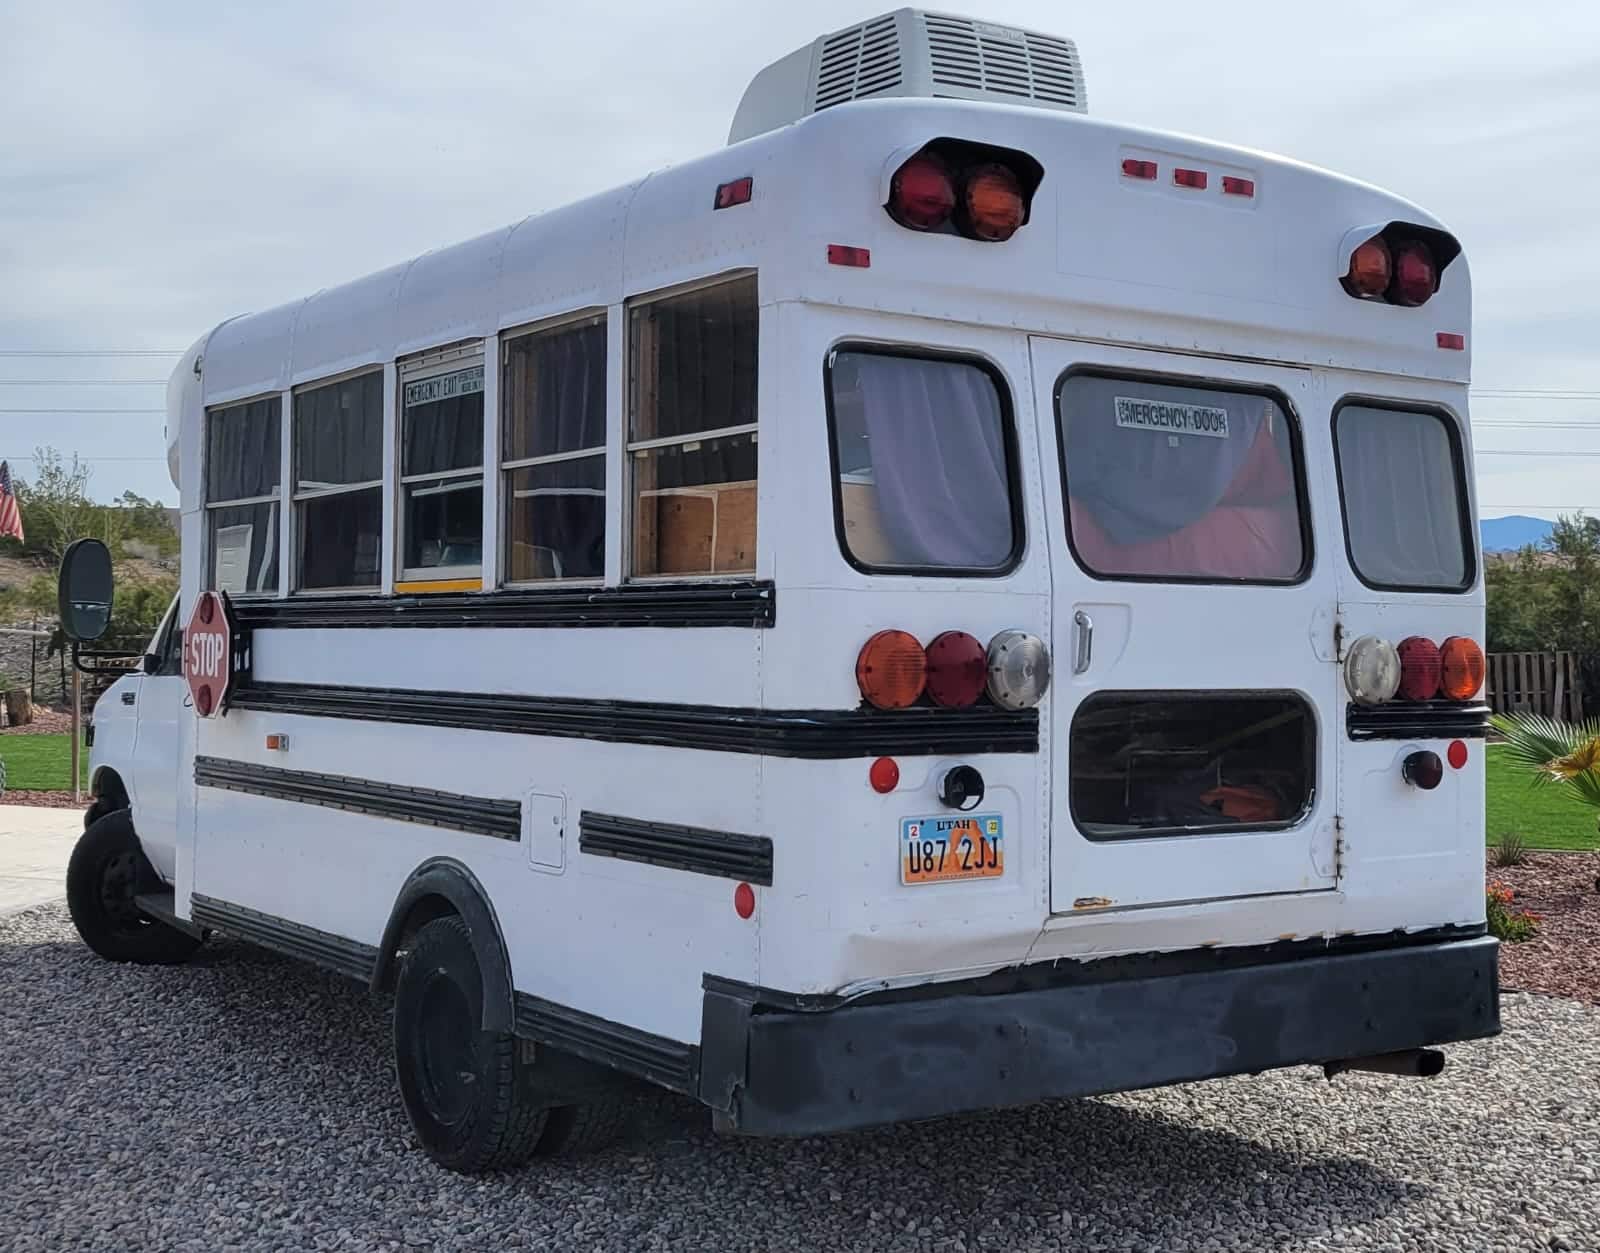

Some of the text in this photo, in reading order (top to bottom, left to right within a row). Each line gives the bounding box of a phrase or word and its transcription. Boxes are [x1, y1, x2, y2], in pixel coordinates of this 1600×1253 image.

[443, 375, 457, 396] EXIT
[1118, 400, 1187, 428] EMERGENCY
[191, 632, 224, 678] STOP
[937, 820, 970, 832] UTAH
[909, 836, 998, 873] U87 2JJ
